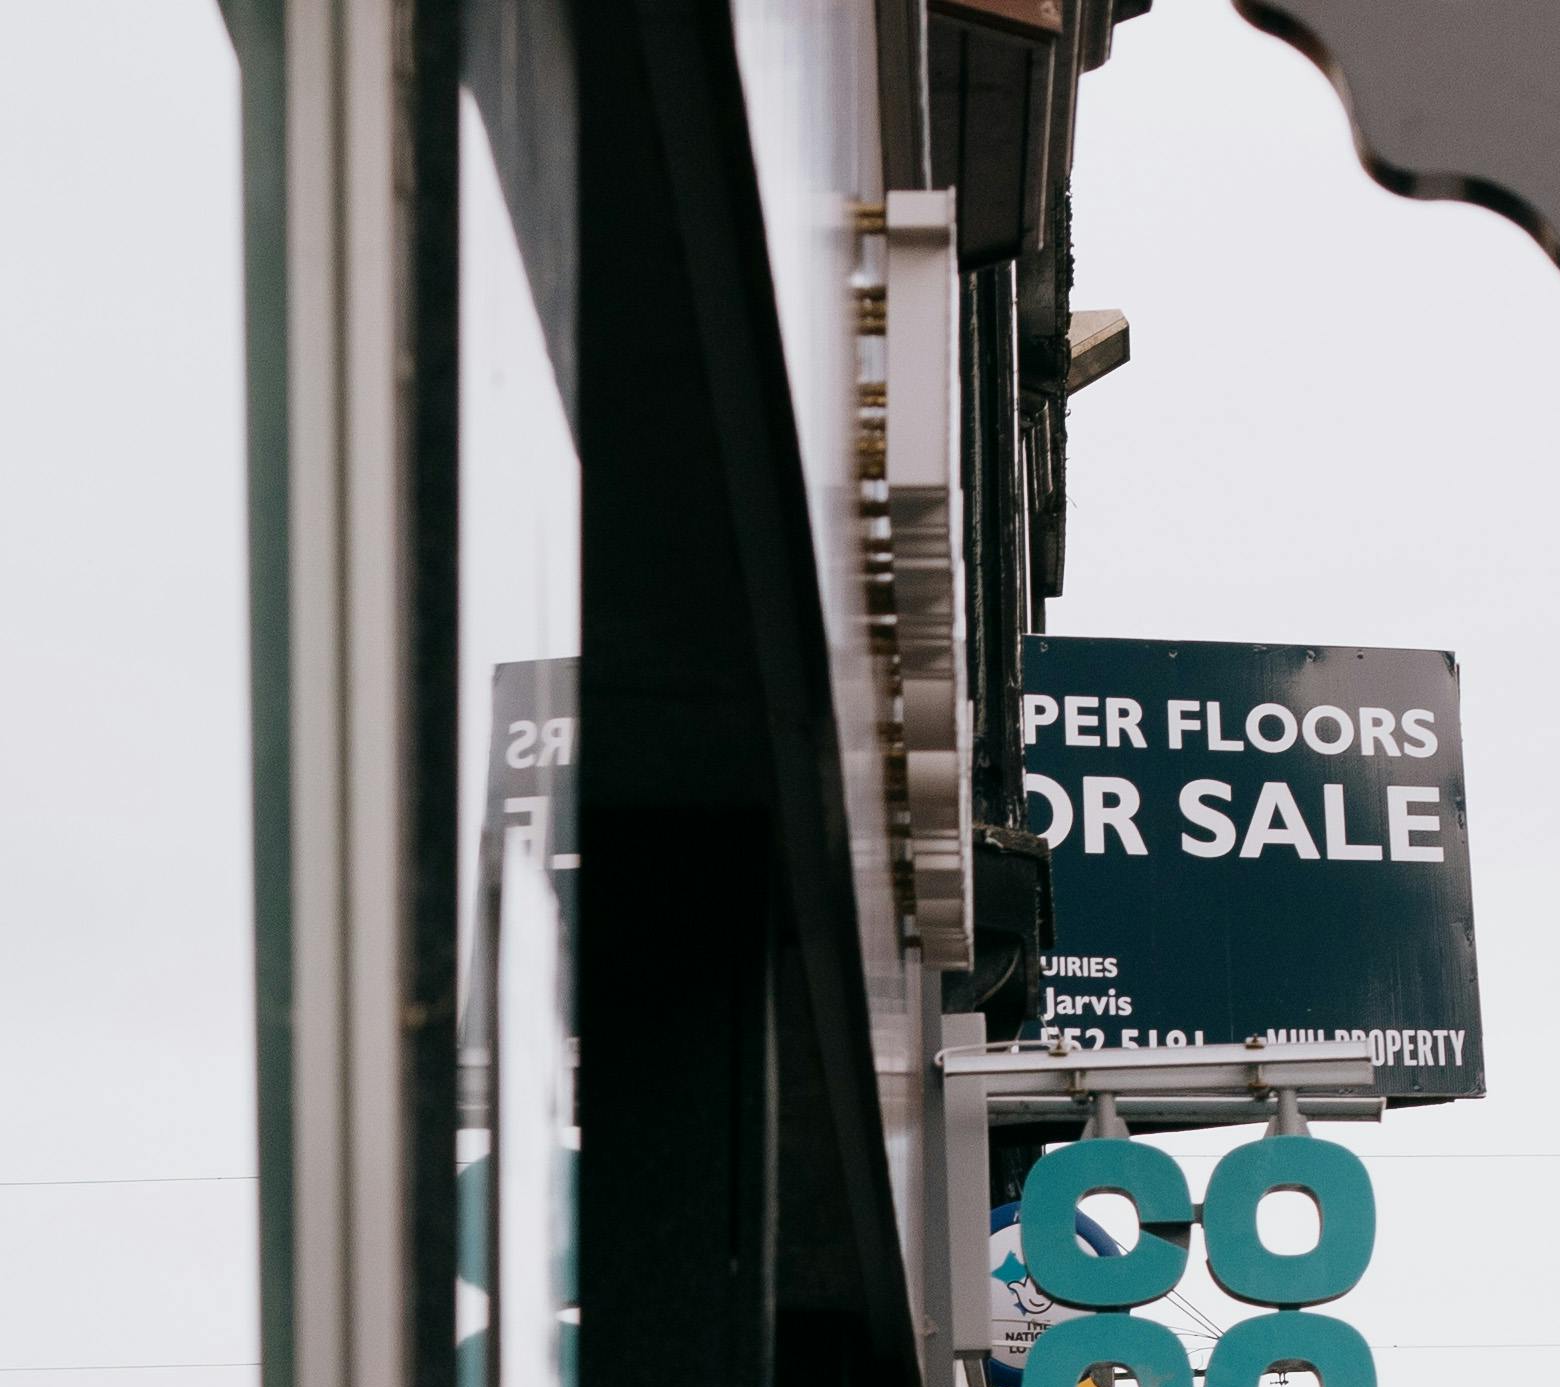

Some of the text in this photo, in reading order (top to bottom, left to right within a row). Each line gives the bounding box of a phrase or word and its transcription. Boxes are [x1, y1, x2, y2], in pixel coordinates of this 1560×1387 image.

[1168, 699, 1438, 758] FLOORS
[1180, 779, 1444, 863] SALE
[1043, 986, 1132, 1021] Jarvis
